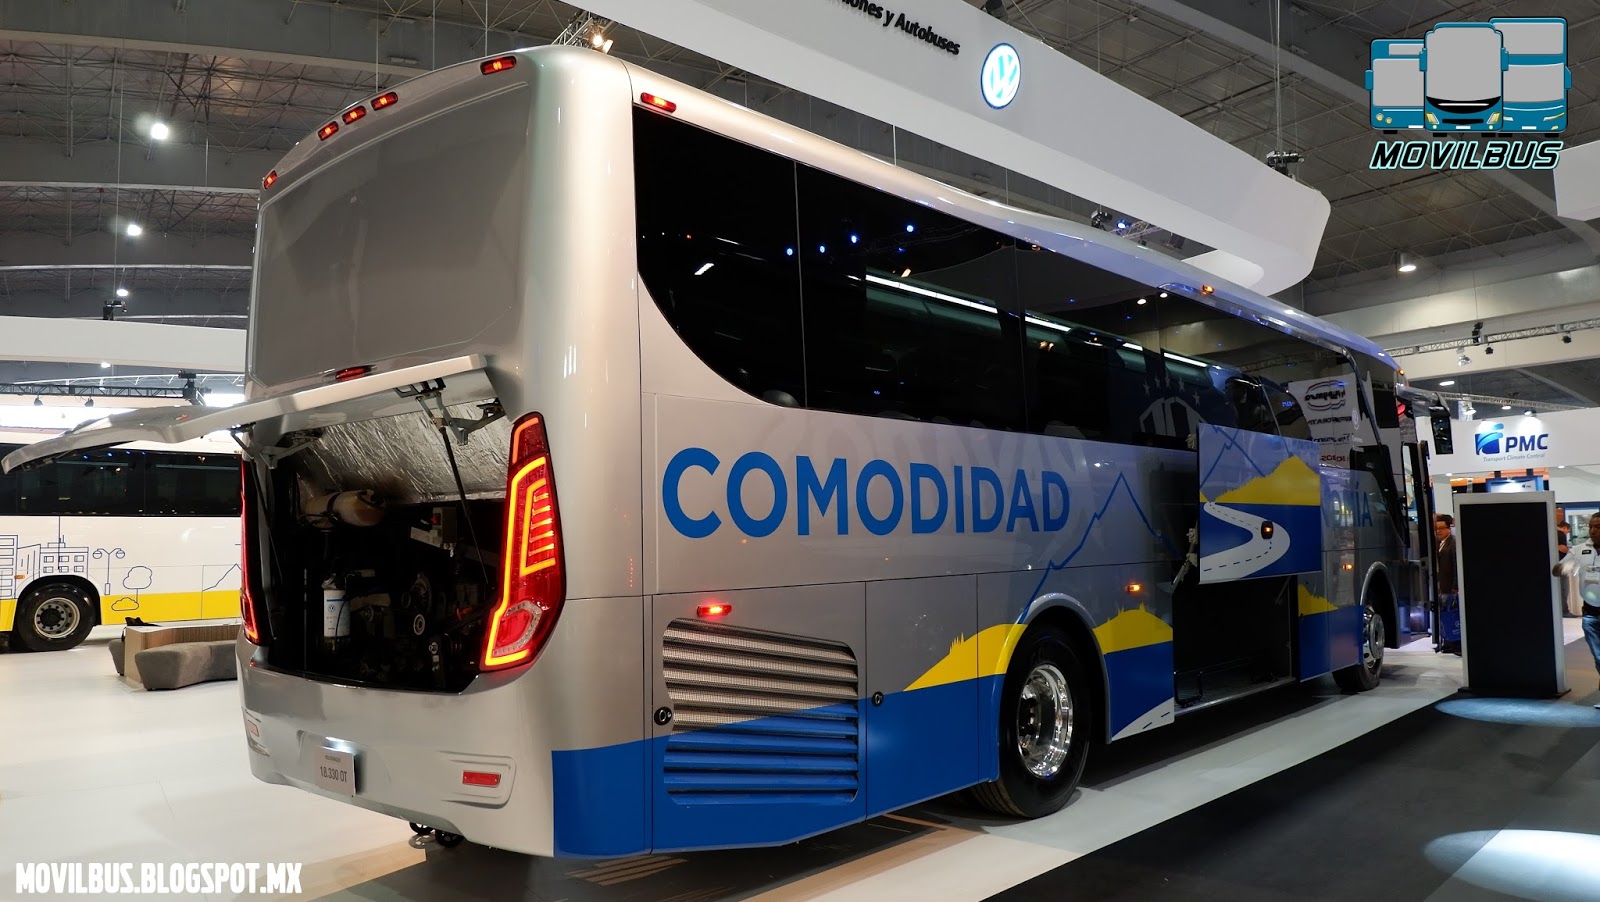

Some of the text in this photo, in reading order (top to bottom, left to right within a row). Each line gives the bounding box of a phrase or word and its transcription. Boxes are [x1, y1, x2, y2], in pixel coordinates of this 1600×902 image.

[883, 10, 895, 27] y
[894, 13, 960, 55] Autobuses
[1505, 433, 1549, 453] PMC
[1506, 453, 1526, 461] Climate
[1526, 452, 1546, 460] Control
[662, 447, 1070, 538] COMODIDAD
[320, 766, 339, 781] 18.330
